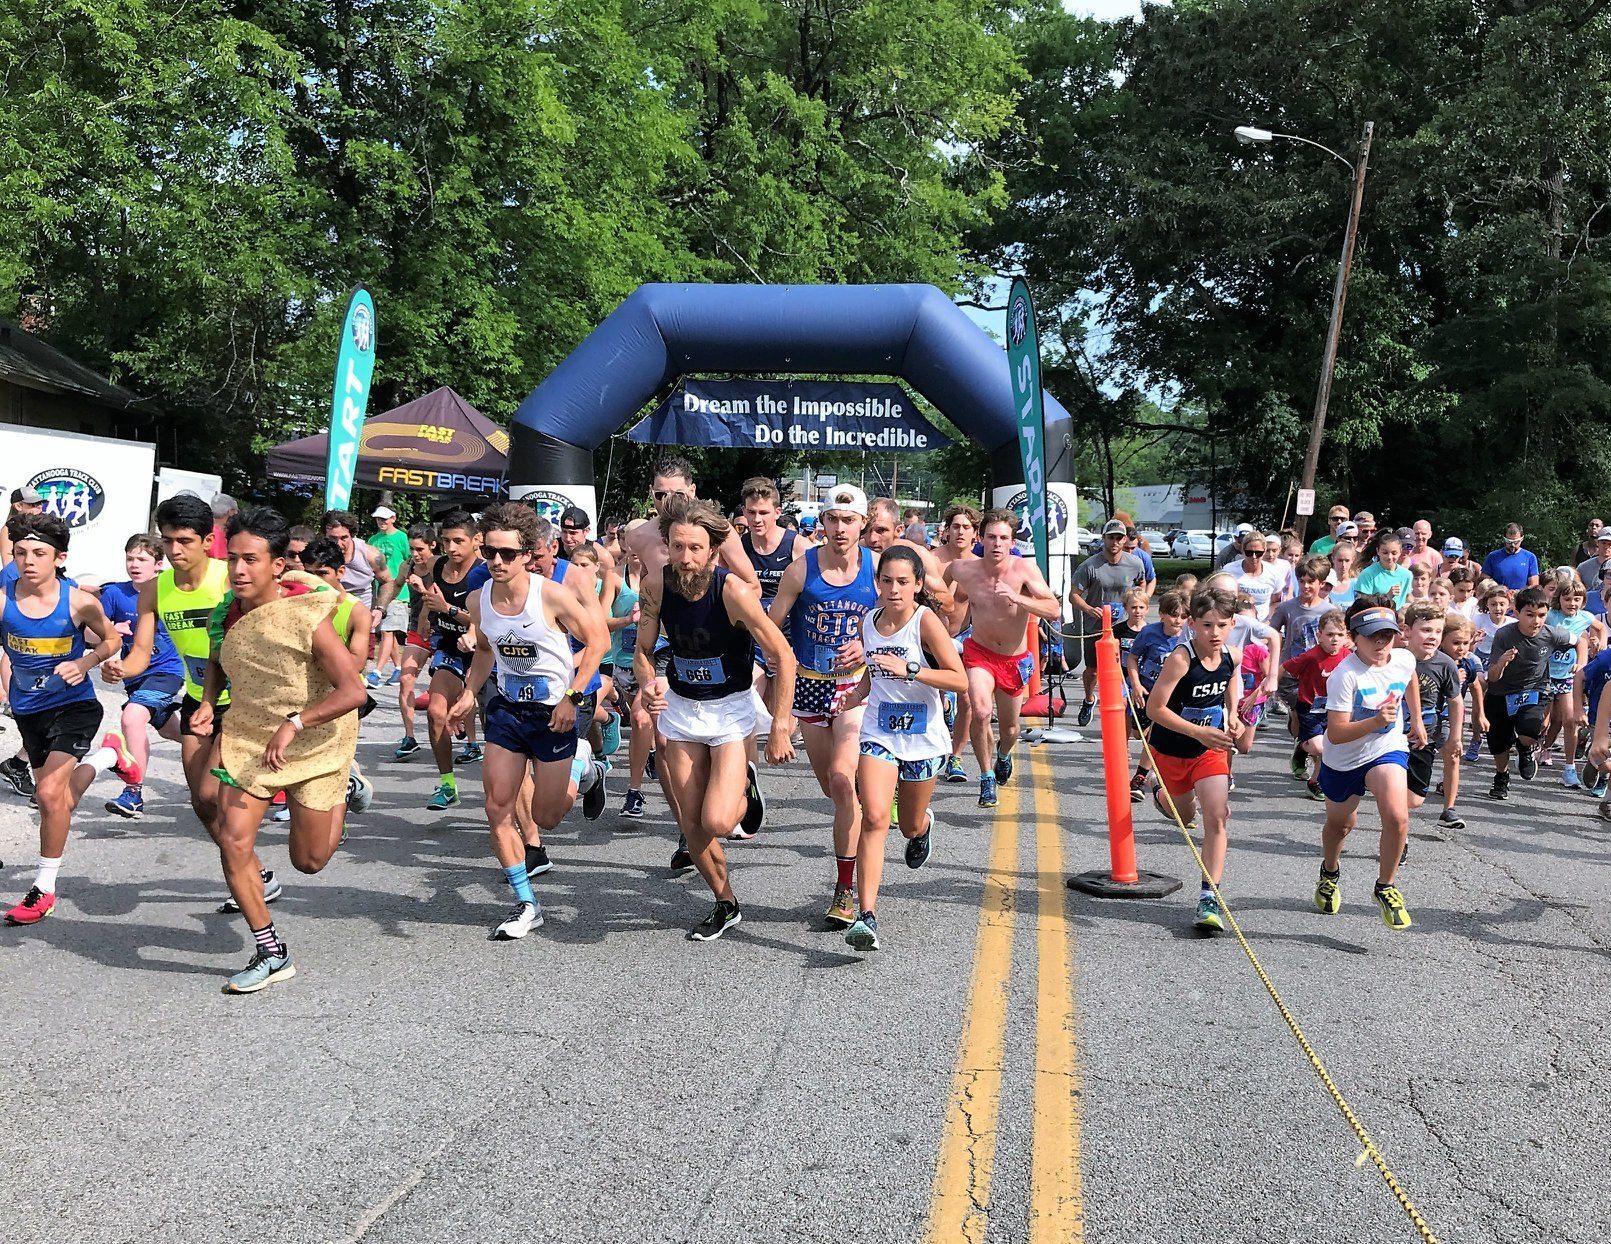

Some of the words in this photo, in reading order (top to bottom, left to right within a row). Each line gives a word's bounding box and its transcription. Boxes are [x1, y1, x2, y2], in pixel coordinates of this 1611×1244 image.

[684, 393, 750, 414] Dream
[755, 394, 787, 414] the
[793, 396, 903, 421] Impossible
[331, 356, 364, 511] TART
[754, 424, 784, 444] Do
[788, 425, 820, 445] the
[825, 426, 928, 448] Incredible
[29, 468, 69, 489] ATTANOOGA
[69, 469, 89, 483] TRACK
[87, 478, 102, 495] CLUB
[377, 466, 510, 495] FASTBREAK
[522, 492, 547, 501] NOOGA
[164, 611, 185, 621] FAST
[808, 599, 872, 616] CHATTANOOG
[166, 620, 195, 631] BREAK
[816, 612, 860, 637] CTC
[9, 632, 29, 647] FAST
[806, 629, 836, 645] TRACK
[503, 646, 530, 656] CJTC
[518, 686, 534, 701] 49
[1192, 680, 1228, 698] CSAS
[888, 714, 915, 731] 347
